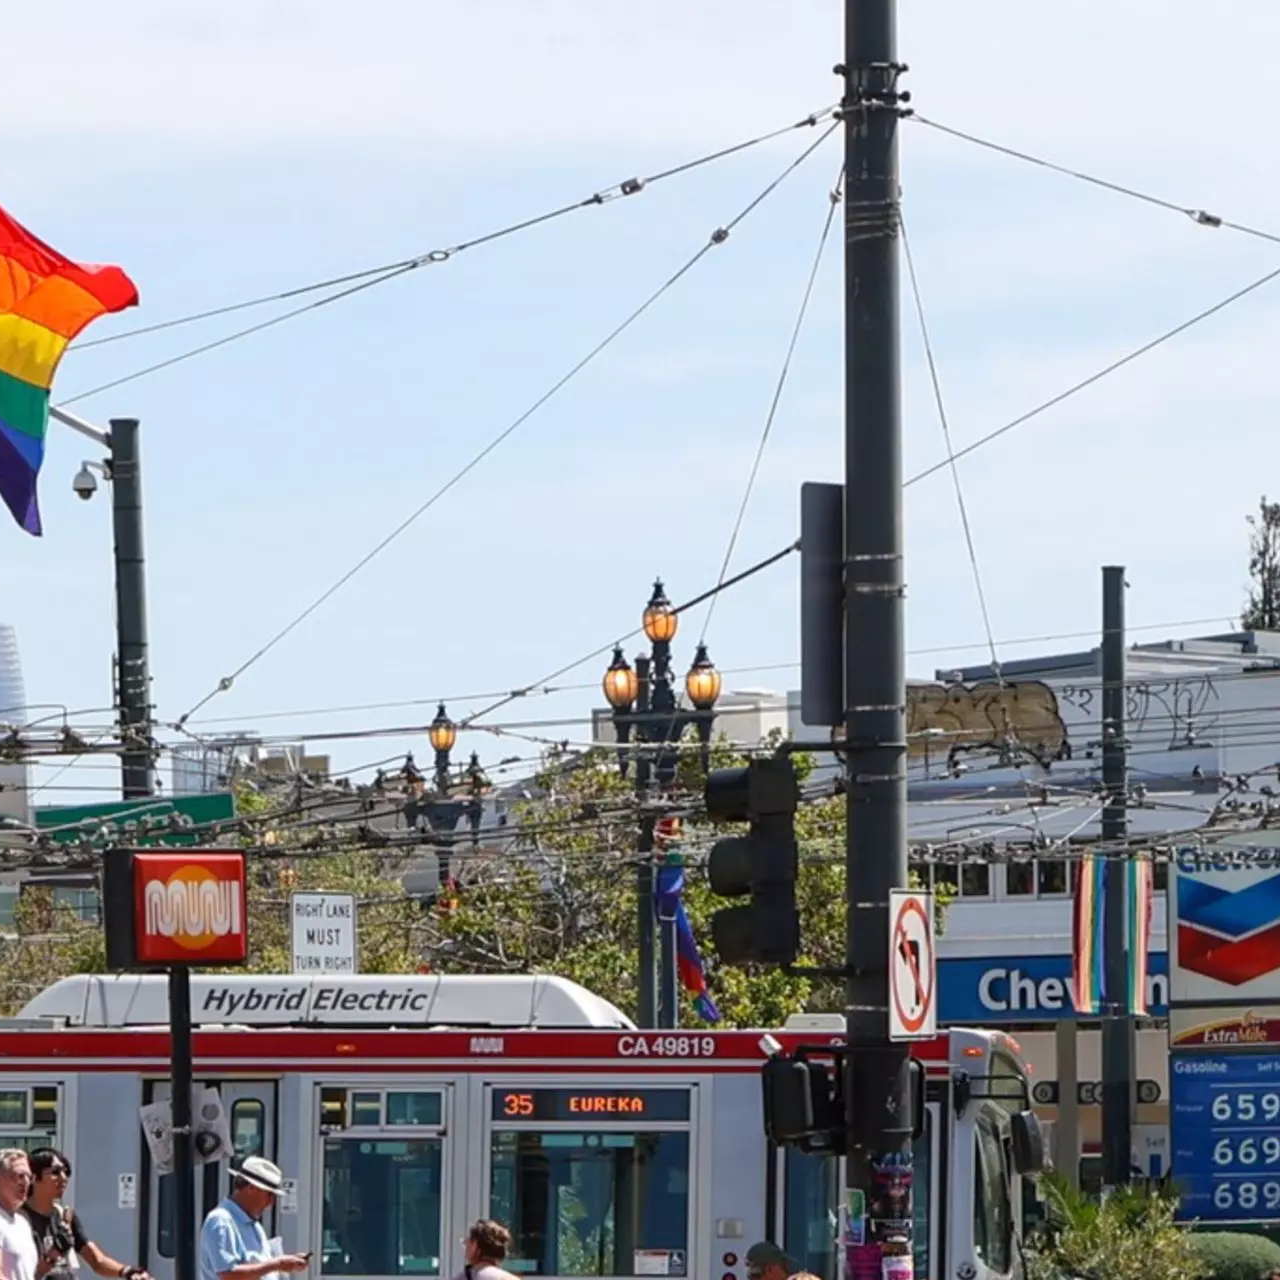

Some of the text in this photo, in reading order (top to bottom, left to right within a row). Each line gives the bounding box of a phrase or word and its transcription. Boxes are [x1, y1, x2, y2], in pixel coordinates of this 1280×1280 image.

[296, 903, 351, 918] RIGHT LANE
[307, 928, 341, 945] MUST
[296, 955, 352, 970] TURN RIGHT
[202, 988, 428, 1016] Hybrid Electric
[618, 1036, 715, 1056] CA 49819
[1174, 1060, 1228, 1073] Gasoline
[504, 1094, 643, 1115] 35 EUREKA
[1212, 1093, 1280, 1121] 659
